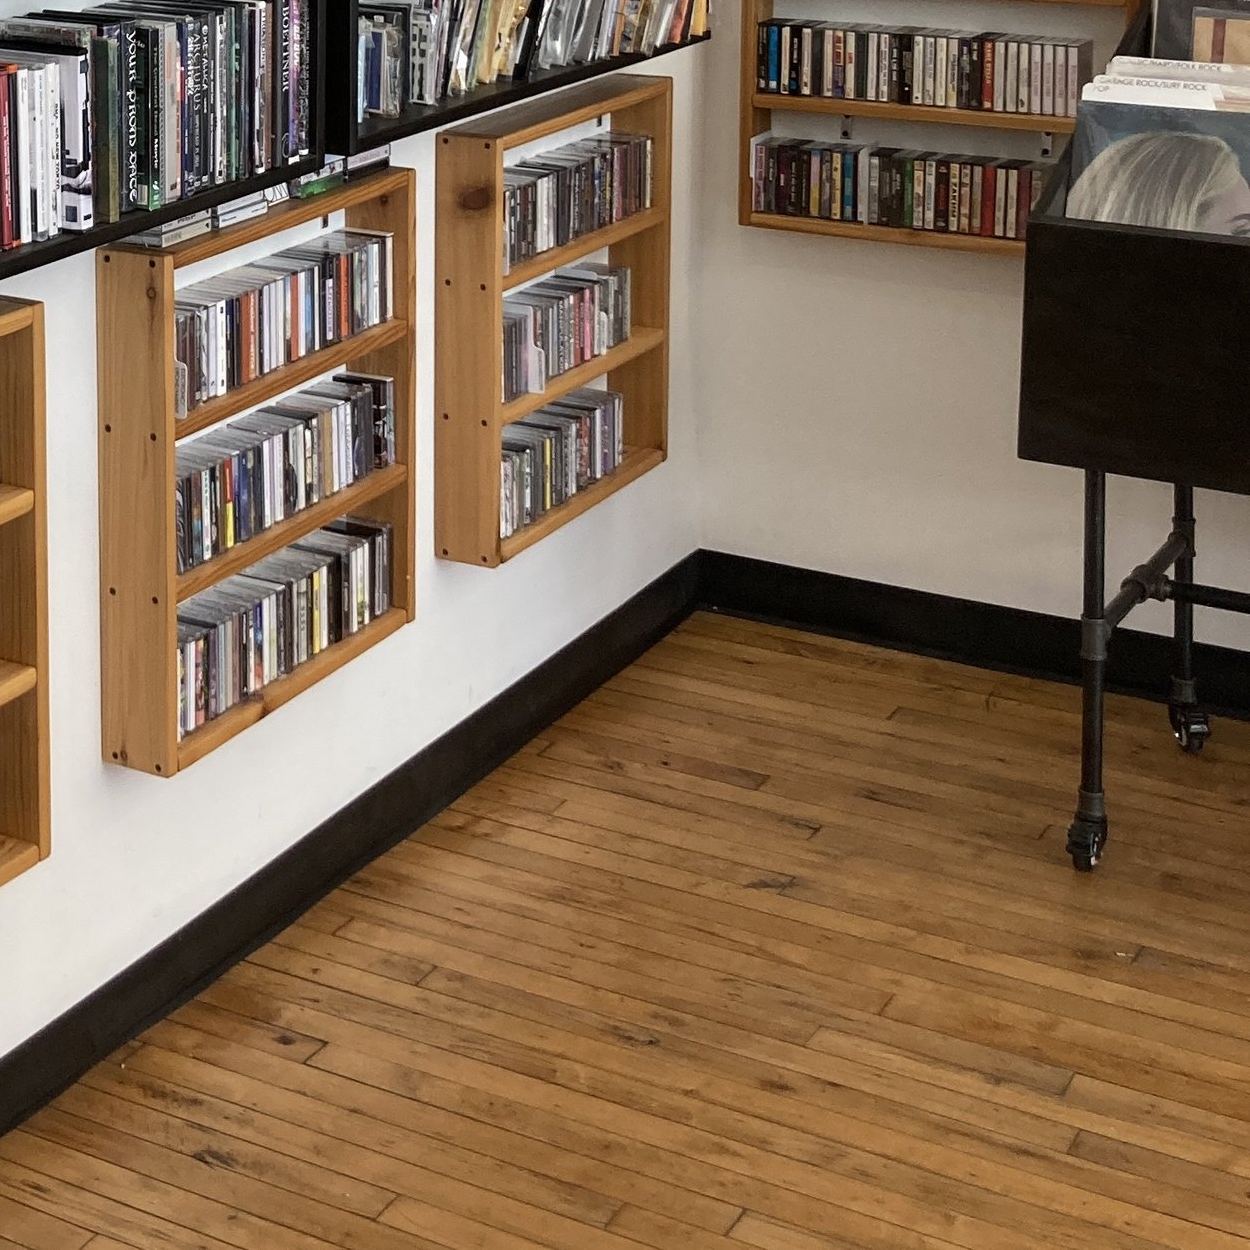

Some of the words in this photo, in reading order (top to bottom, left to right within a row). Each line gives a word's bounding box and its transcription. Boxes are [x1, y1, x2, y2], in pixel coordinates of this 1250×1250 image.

[126, 30, 138, 82] YOUR
[193, 33, 201, 111] ARCTURUS
[281, 5, 290, 92] BOETTNER
[1198, 64, 1222, 72] ROCK
[1135, 79, 1182, 90] ROCK/SURF
[1183, 83, 1207, 92] ROCK
[126, 88, 138, 147] PROM
[128, 150, 138, 202] DATE
